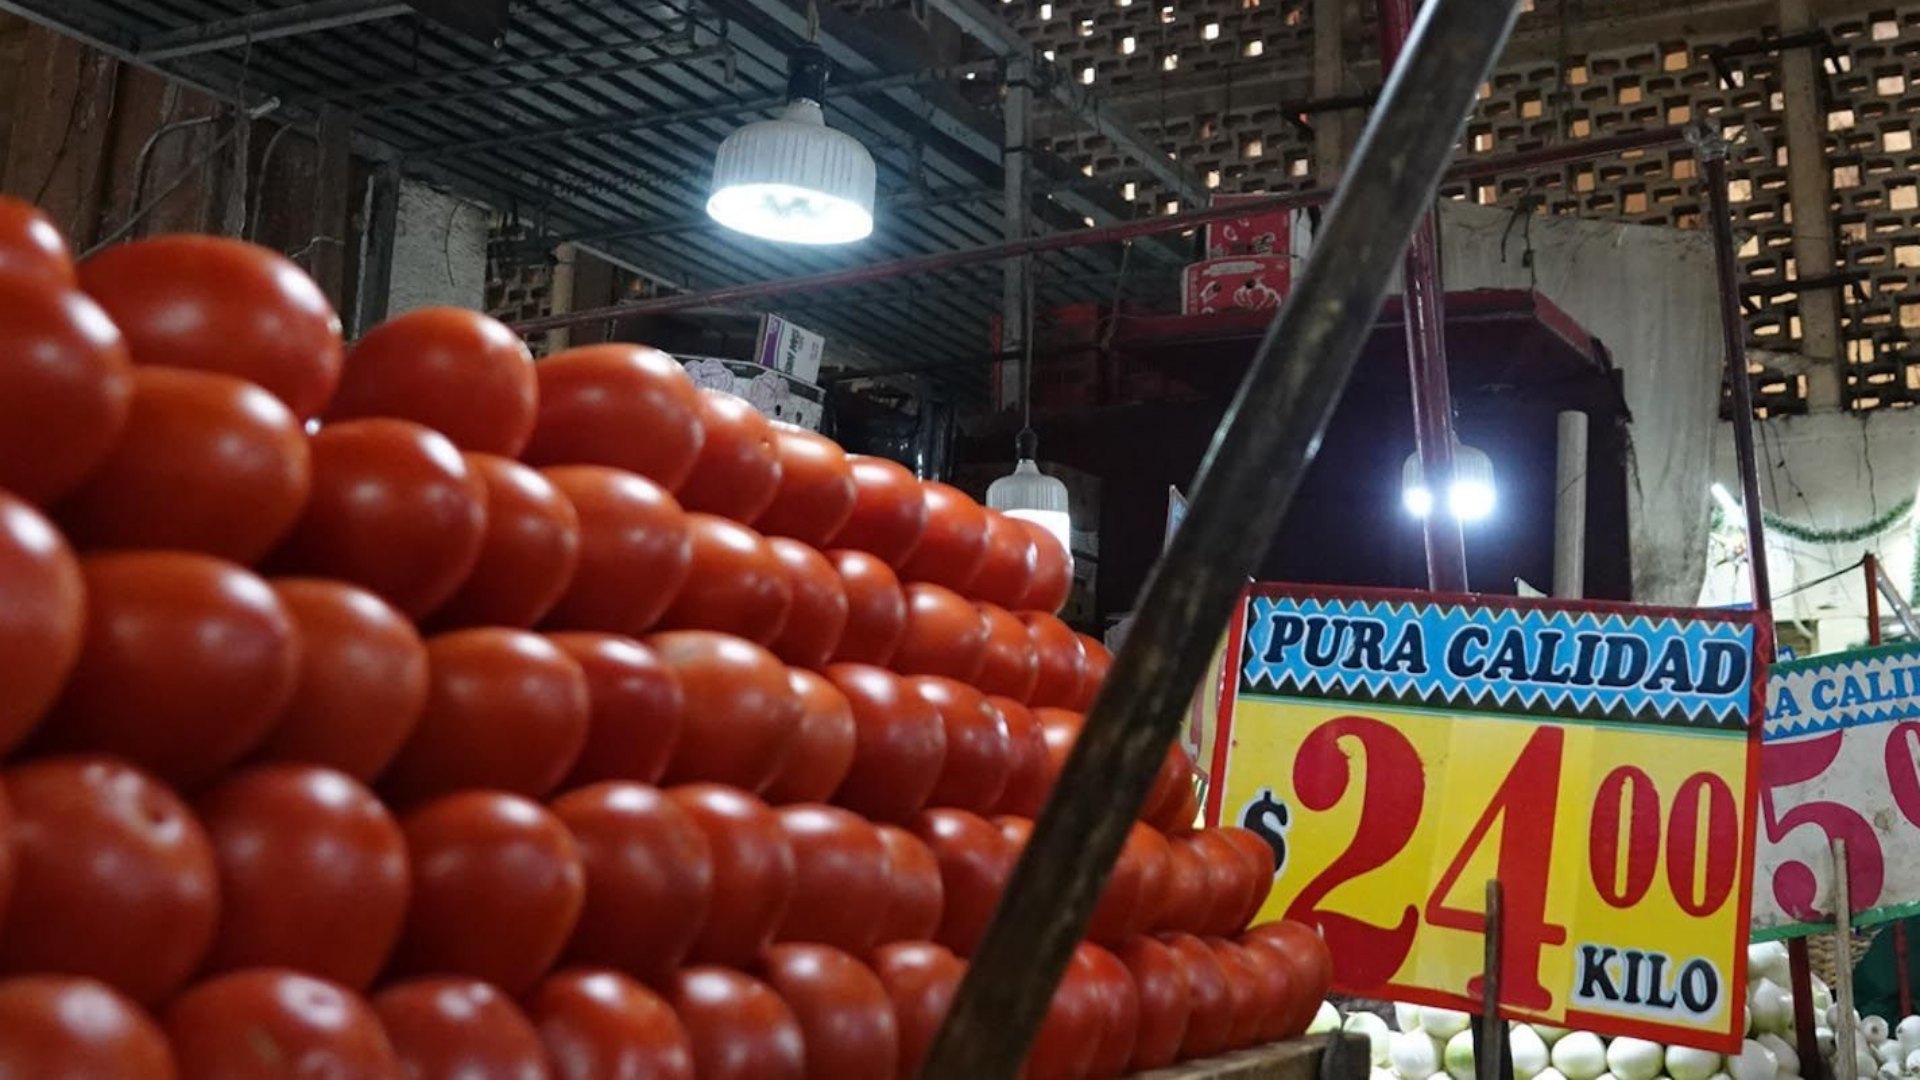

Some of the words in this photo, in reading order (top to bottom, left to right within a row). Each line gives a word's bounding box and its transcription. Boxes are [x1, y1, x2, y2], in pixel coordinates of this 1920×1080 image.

[1264, 614, 1428, 676] PURA
[1446, 624, 1747, 695] CALIDAD
[1579, 945, 1718, 1013] KILO
